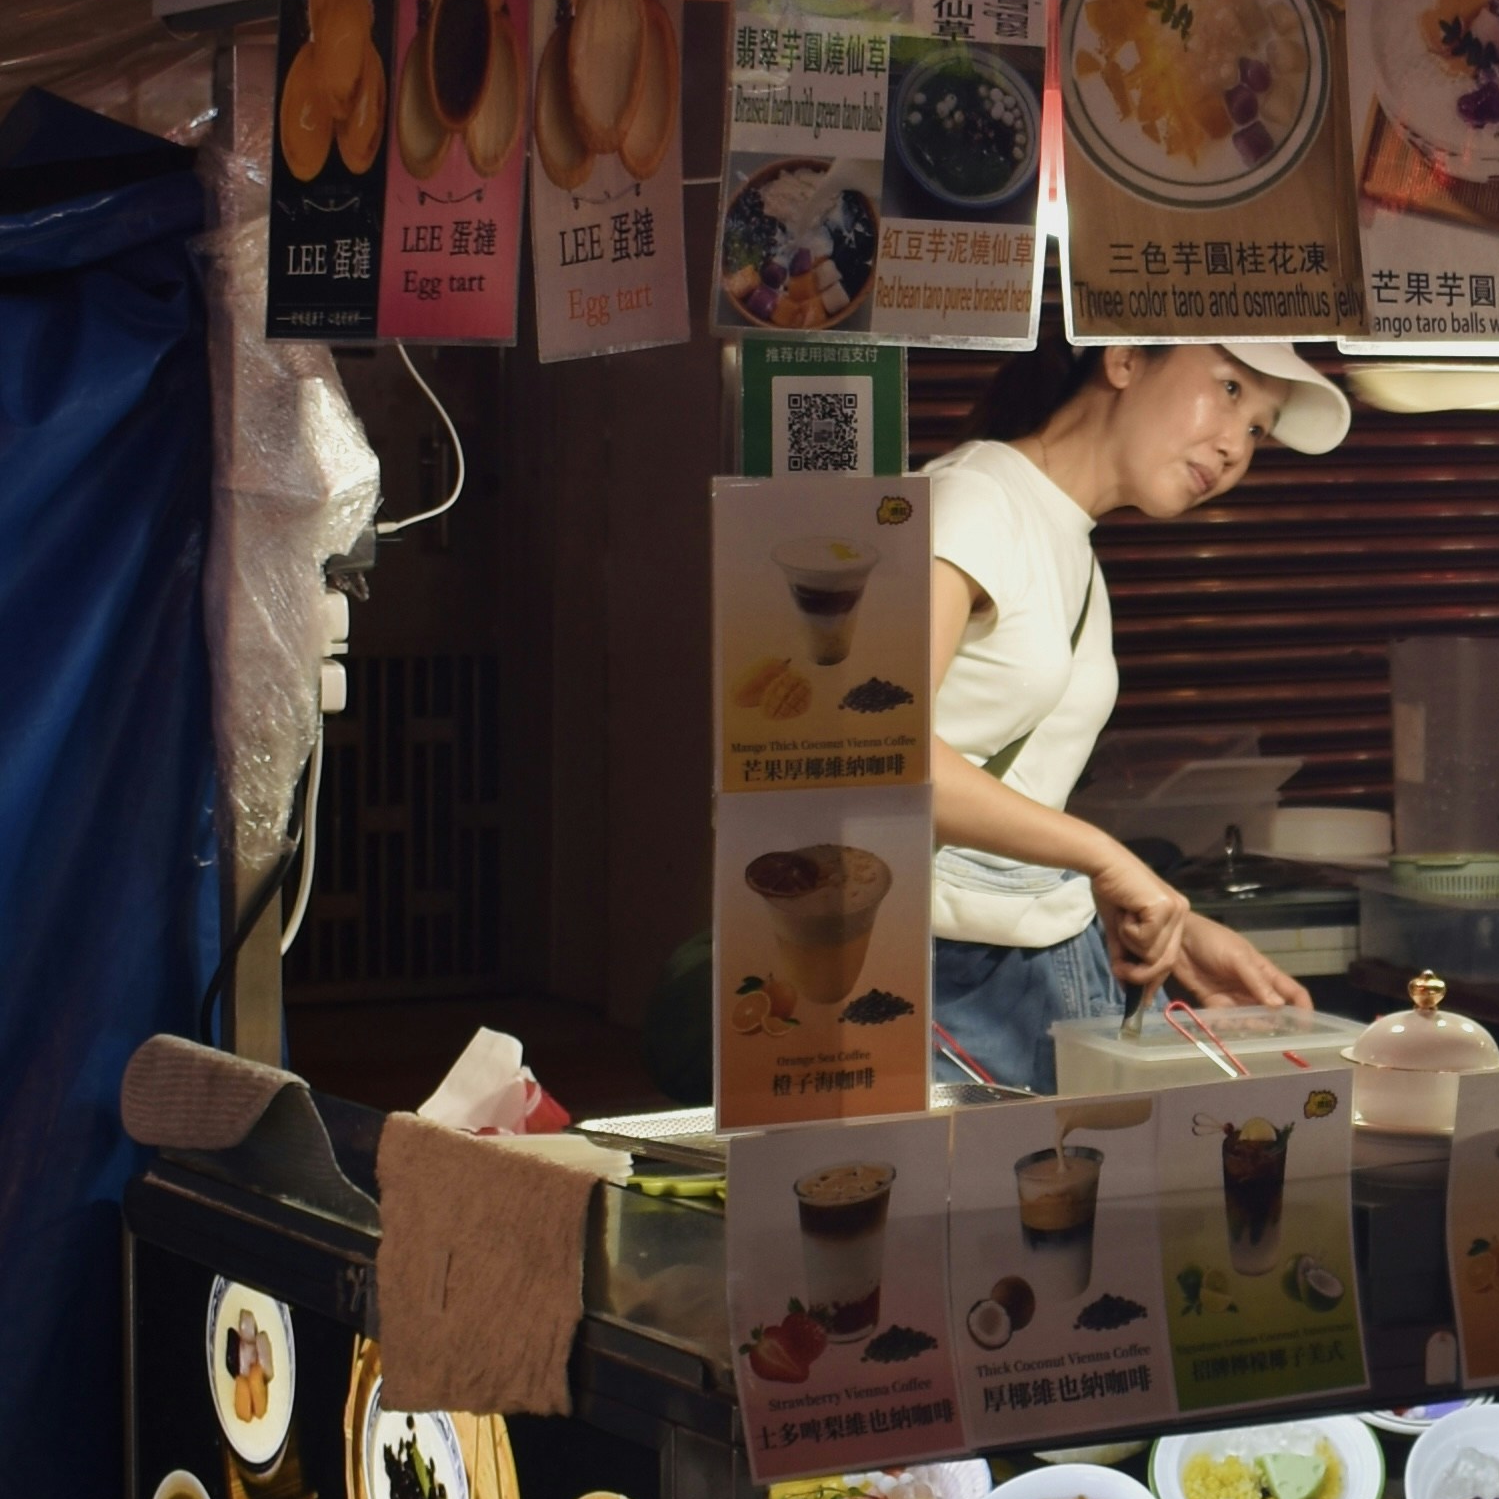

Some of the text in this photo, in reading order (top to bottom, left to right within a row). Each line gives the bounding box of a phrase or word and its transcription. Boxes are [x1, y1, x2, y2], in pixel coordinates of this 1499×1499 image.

[736, 26, 887, 78] 翡翠芋圓燒仙草
[771, 85, 792, 126] herb
[793, 87, 813, 129] with
[813, 93, 841, 139] green
[842, 95, 862, 132] taro
[862, 93, 883, 133] balls
[402, 219, 498, 257] LEE 蛋撻
[560, 208, 656, 267] LEE 蛋撻
[881, 227, 1034, 267] 紅豆芋泥燒仙草
[287, 236, 371, 281] LEE 蛋撻
[1109, 241, 1329, 276] 三色芋圓桂花凍
[403, 270, 485, 300] Egg tart
[876, 276, 1033, 320] Red bean taro puree braised herb
[1074, 281, 1365, 327] Three color taro and osmanthus jelly
[568, 284, 653, 328] Egg tart
[1374, 316, 1413, 340] ango
[1415, 315, 1448, 335] taro
[1450, 312, 1486, 335] balls
[731, 734, 917, 755] Mango Thick Coconut Vienna Coffee
[837, 1050, 871, 1061] Coffee
[772, 1067, 876, 1096] 橙子海咖啡
[976, 1344, 1152, 1378] Thick Coconut Vienna Coffee
[768, 1377, 932, 1412] Strawberry Vienna Coffee
[983, 1365, 1153, 1414] 厚椰維也納咖啡
